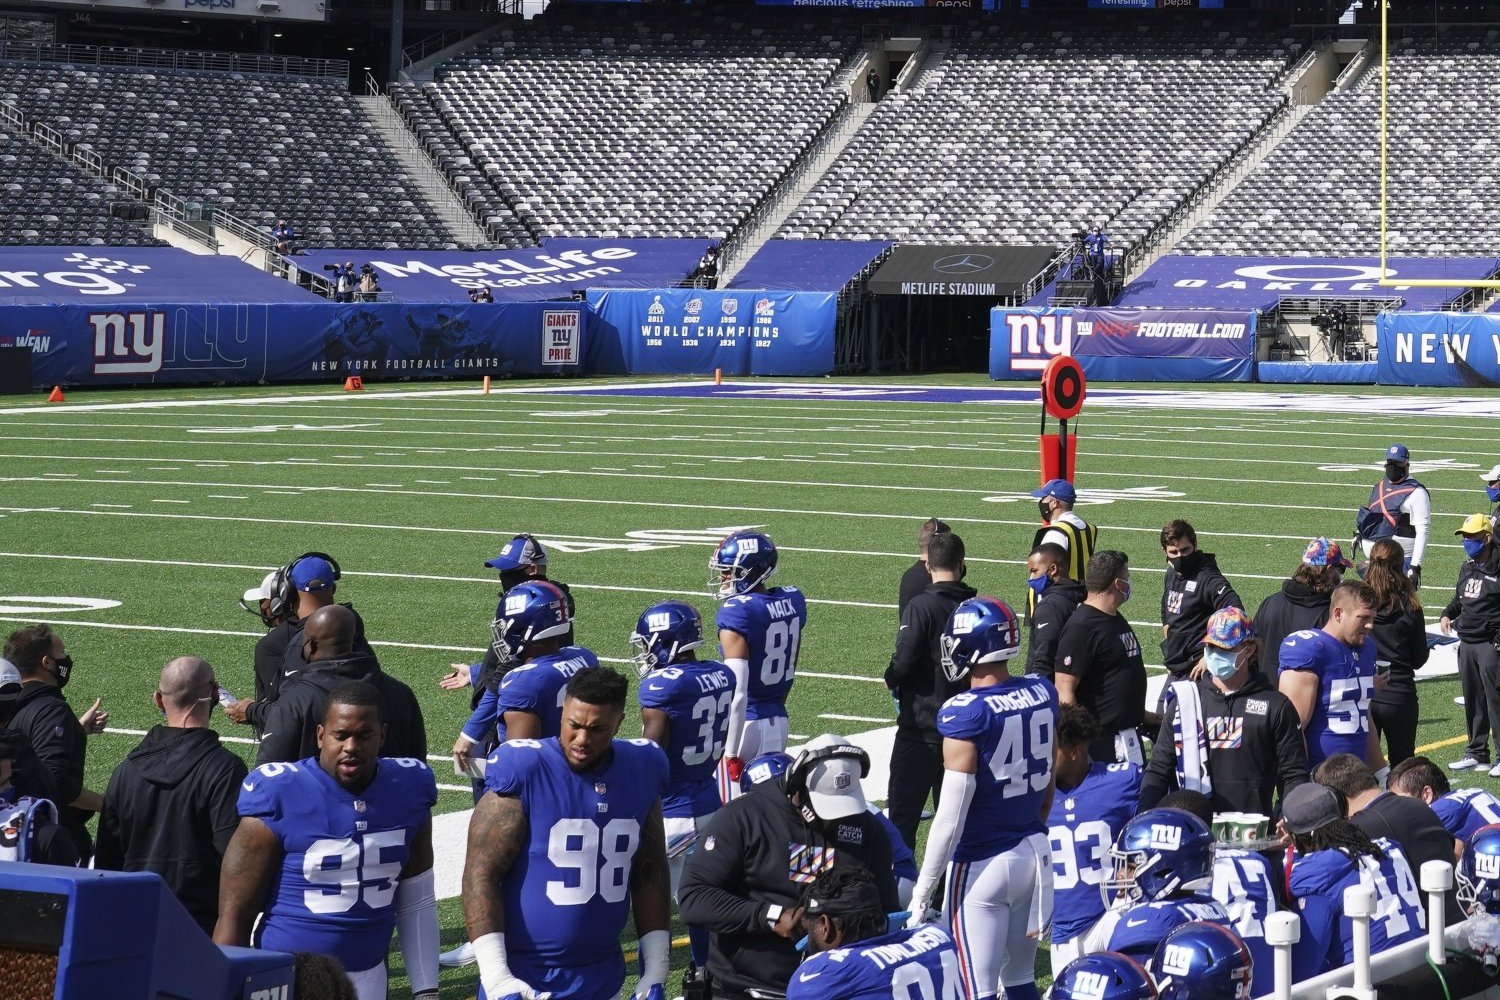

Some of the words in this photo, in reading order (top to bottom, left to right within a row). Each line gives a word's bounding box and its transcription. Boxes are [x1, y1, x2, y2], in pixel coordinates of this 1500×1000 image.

[369, 246, 639, 279] MetLife
[451, 266, 622, 290] Stadium
[901, 282, 945, 295] METLIFE
[949, 282, 996, 295] STADIUM
[547, 314, 576, 327] GIANTS
[641, 325, 689, 336] WORLD
[697, 326, 779, 338] CHAMPIONS
[1136, 323, 1245, 339] FOOTBALL.COM
[548, 348, 572, 361] PRIDE
[1396, 333, 1470, 363] NEW
[312, 360, 338, 371] NEW
[347, 359, 377, 370] YORK
[386, 358, 446, 370] FOOTBALL
[454, 358, 499, 368] GIANTS
[766, 598, 796, 618] MACK
[760, 617, 800, 686] 81
[695, 671, 729, 691] LEWIS
[989, 684, 1050, 714] COUGHLIN
[682, 689, 734, 766] 33
[989, 708, 1055, 799] 49
[838, 830, 863, 840] CATCH
[1150, 824, 1182, 850] ny
[546, 818, 641, 906] 98
[1049, 821, 1113, 890] 93
[302, 829, 407, 914] 95
